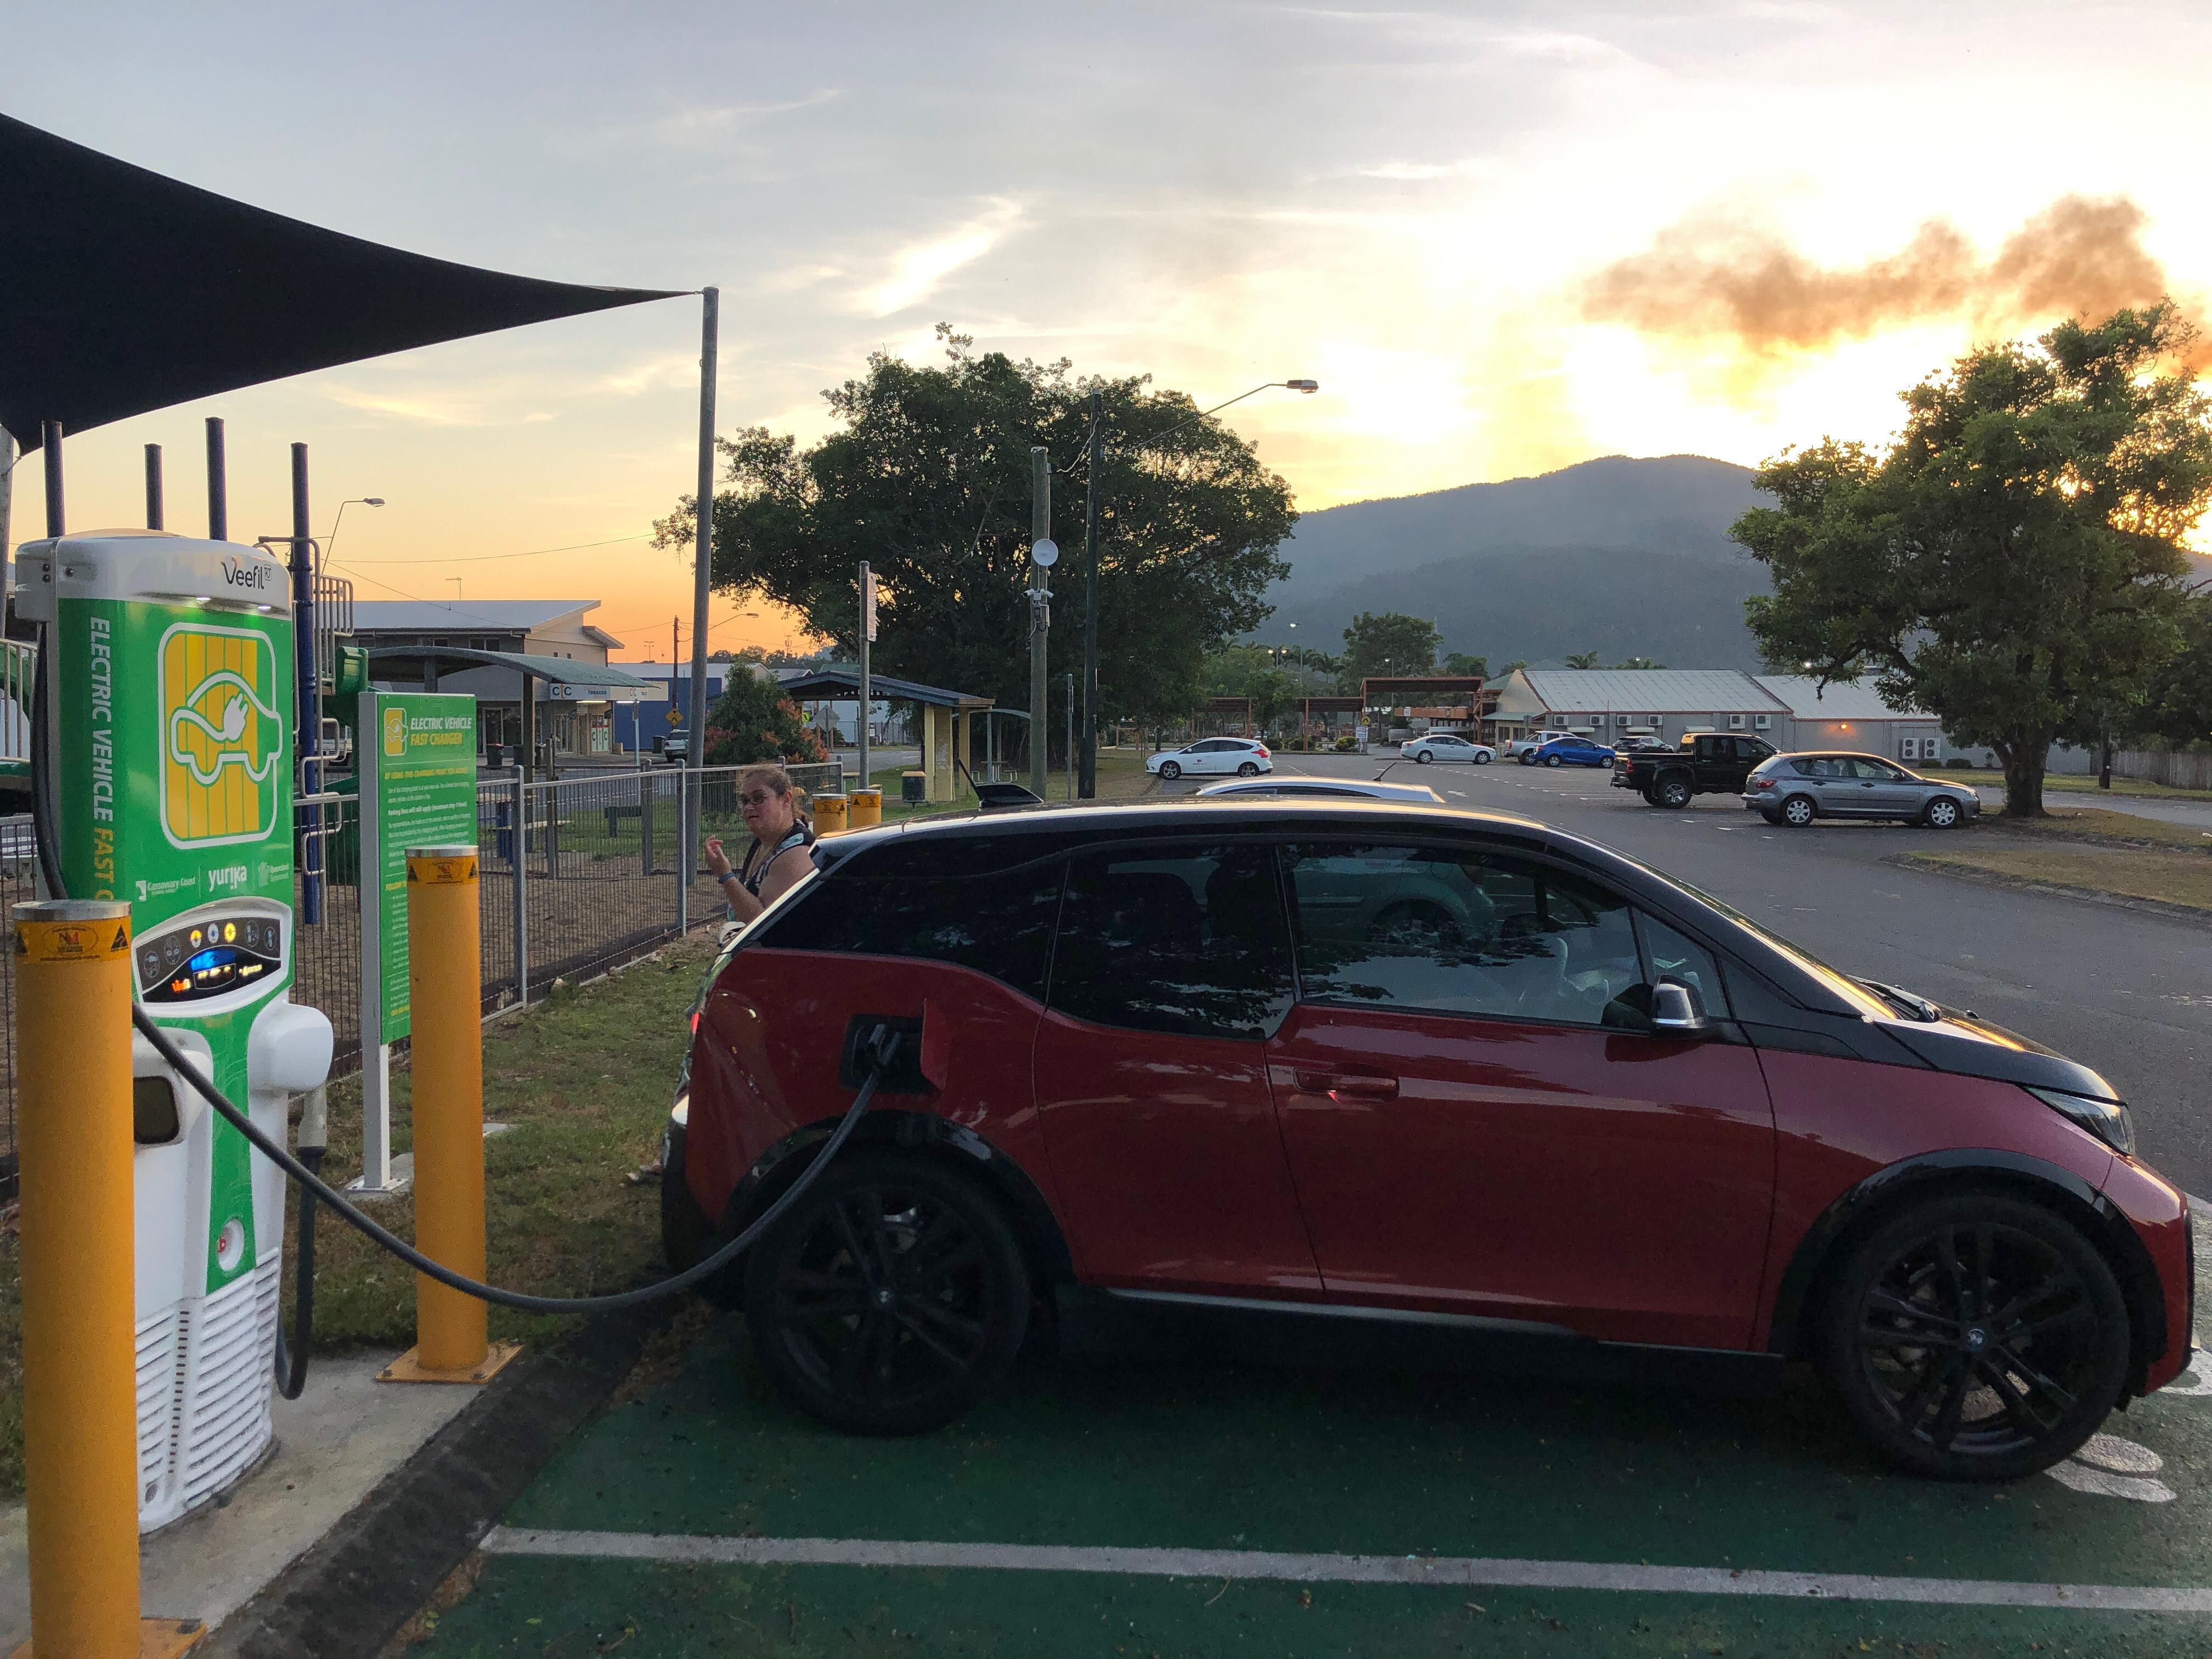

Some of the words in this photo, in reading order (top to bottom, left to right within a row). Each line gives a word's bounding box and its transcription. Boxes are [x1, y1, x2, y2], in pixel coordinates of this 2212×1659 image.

[220, 557, 264, 590] Veefil
[89, 617, 111, 723] ELECTRIC
[410, 718, 444, 730] ELECTRIC
[445, 717, 472, 730] VEHICLE
[410, 733, 429, 746] FAST
[430, 732, 462, 745] CHARGER
[92, 729, 114, 822] VEHICLE
[93, 827, 115, 885] FAST
[148, 880, 179, 891] Cassowary
[180, 876, 196, 887] Coast
